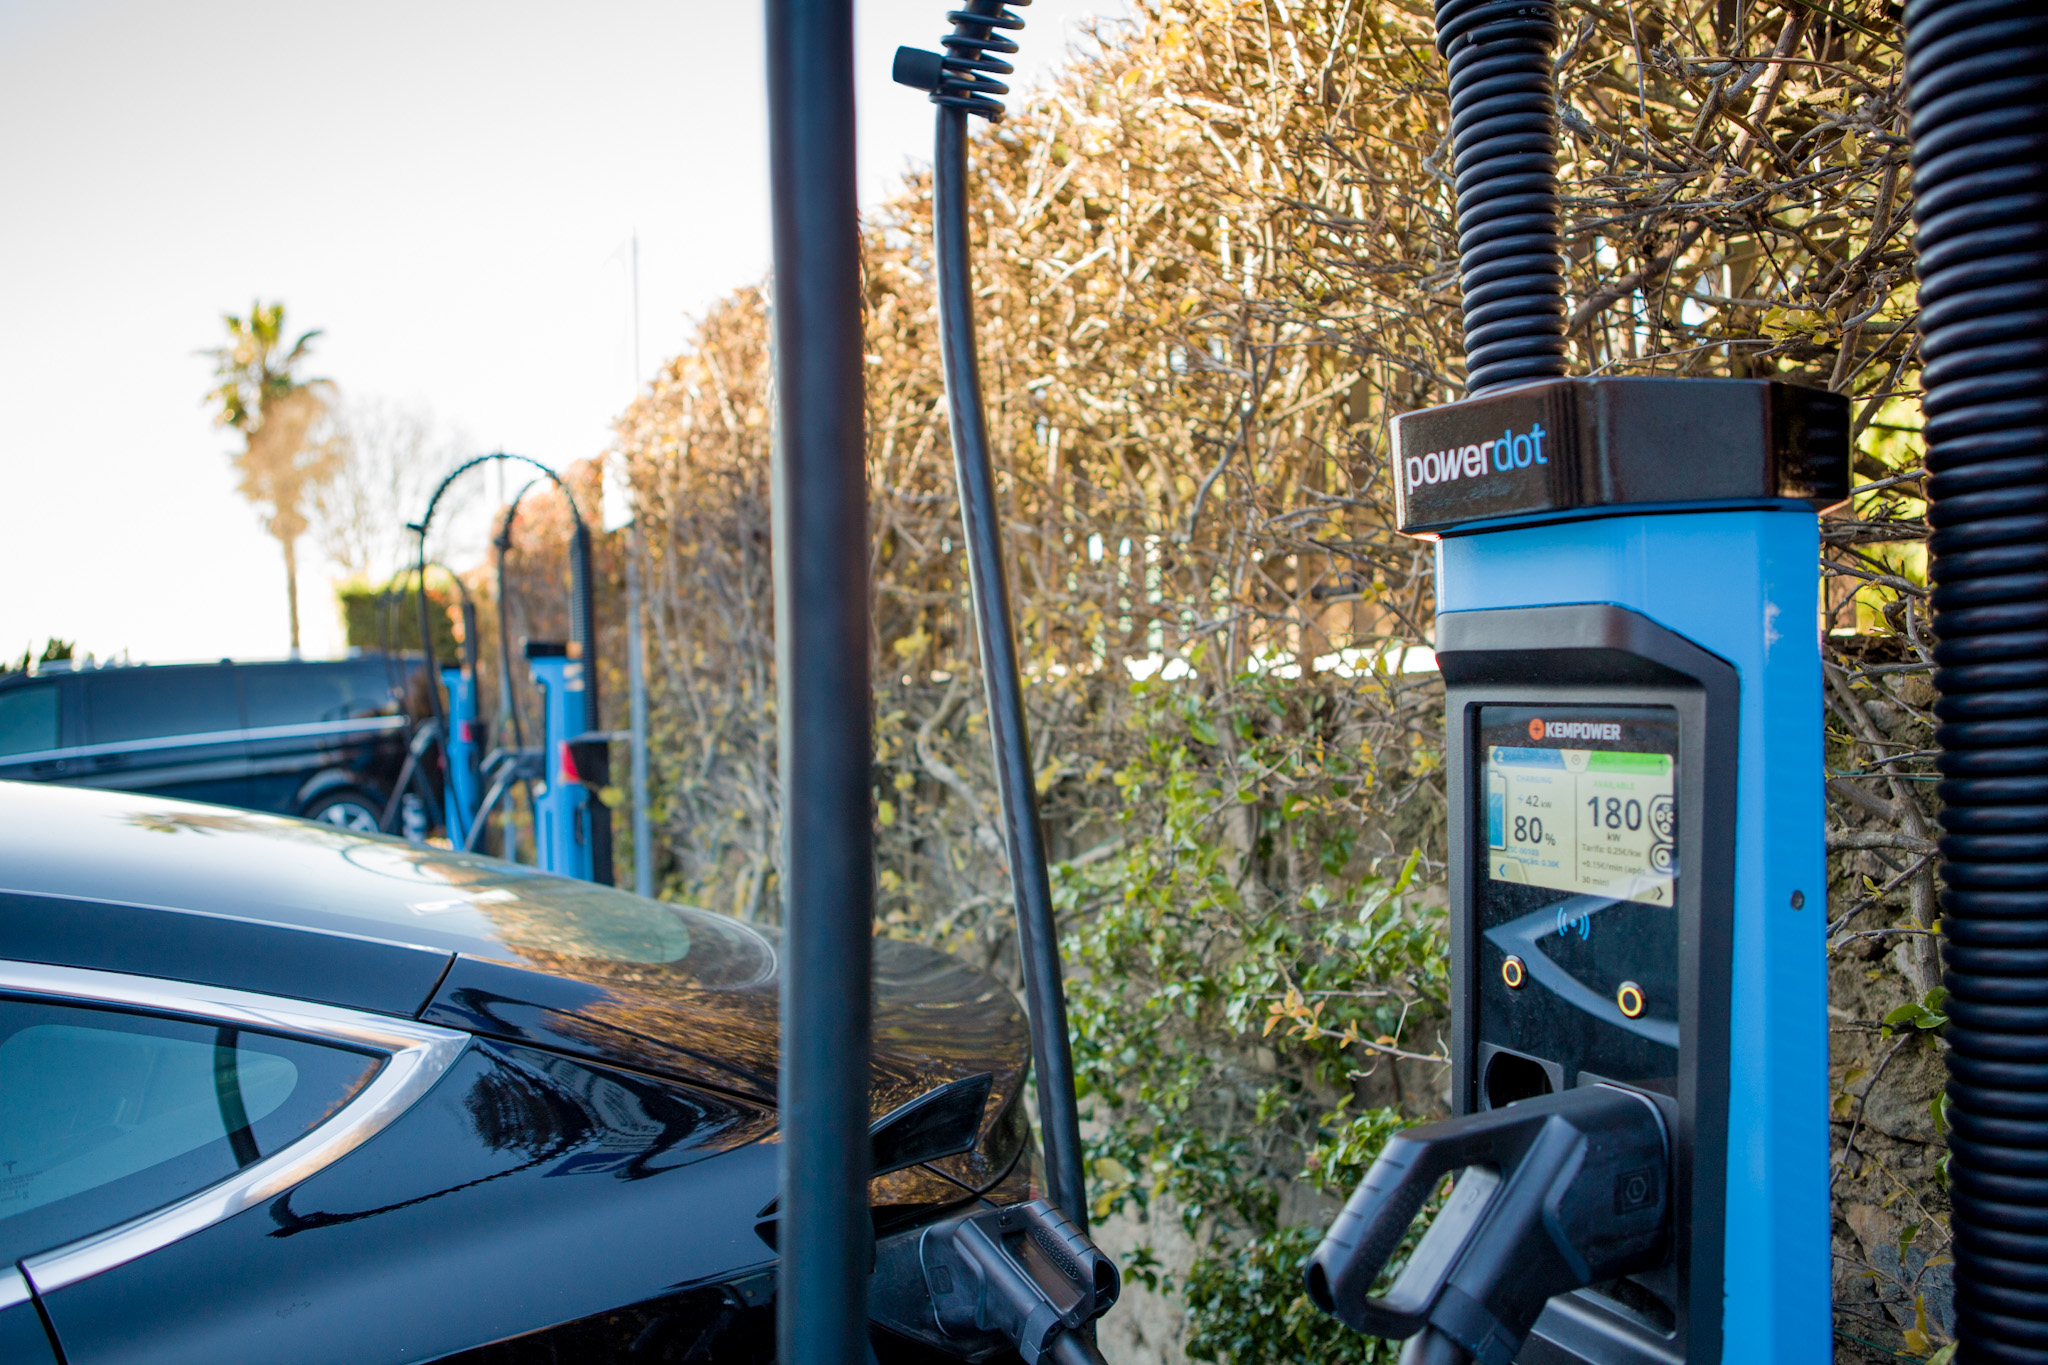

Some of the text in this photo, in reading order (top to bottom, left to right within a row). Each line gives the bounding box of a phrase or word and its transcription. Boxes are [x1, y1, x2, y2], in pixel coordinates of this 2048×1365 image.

[1405, 422, 1548, 495] powerdot
[1545, 721, 1621, 741] KEMPOWER
[1497, 750, 1504, 763] 2
[1516, 774, 1553, 784] CHARGING
[1525, 794, 1539, 808] 42
[1587, 795, 1642, 831] 180
[1514, 815, 1557, 846] 80 %
[1607, 832, 1621, 842] kW
